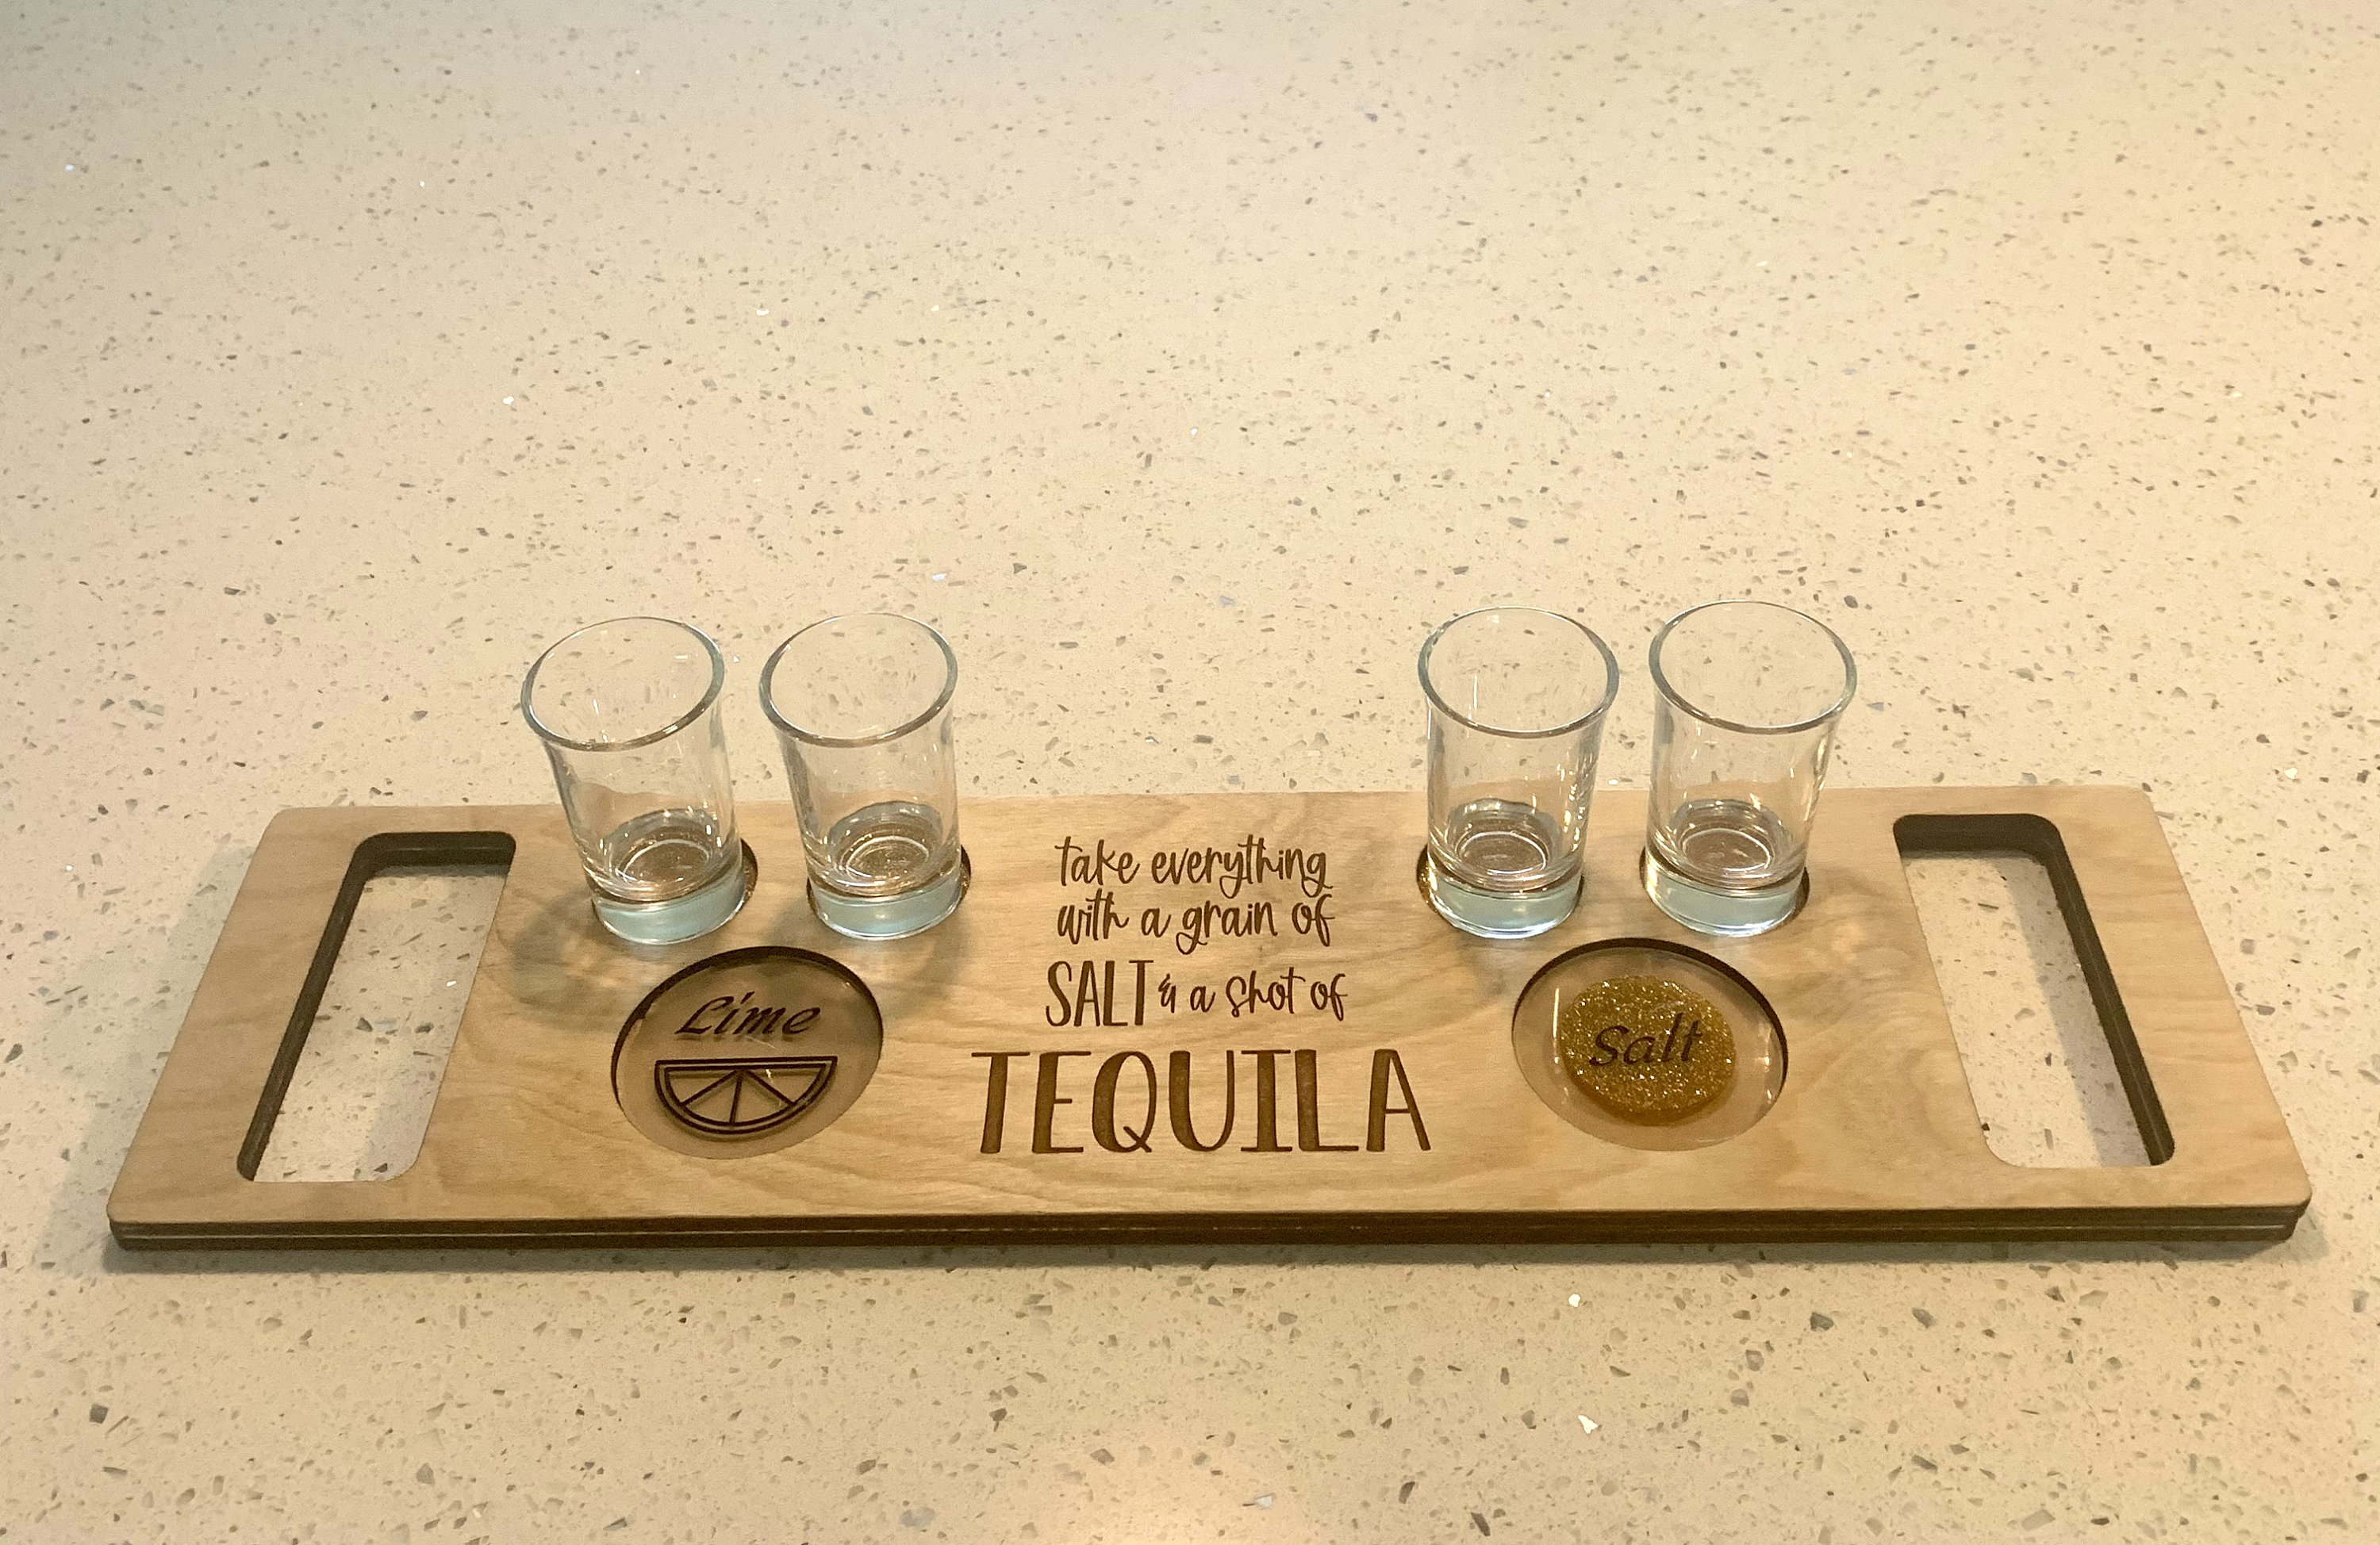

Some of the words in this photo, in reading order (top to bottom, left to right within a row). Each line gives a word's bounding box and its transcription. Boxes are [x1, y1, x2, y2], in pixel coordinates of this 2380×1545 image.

[1055, 836, 1140, 887] take
[1151, 834, 1334, 899] everything
[1058, 889, 1130, 945] with
[1142, 907, 1171, 937] a
[1176, 901, 1278, 955] grain
[1292, 894, 1336, 946] of
[674, 991, 822, 1035] Lime
[1046, 960, 1154, 1027] SALT
[1157, 974, 1177, 1014] &
[1190, 982, 1216, 1014] a
[1311, 973, 1349, 1022] of
[1588, 1012, 1703, 1066] Salt
[971, 1049, 1431, 1154] TEQUILA
